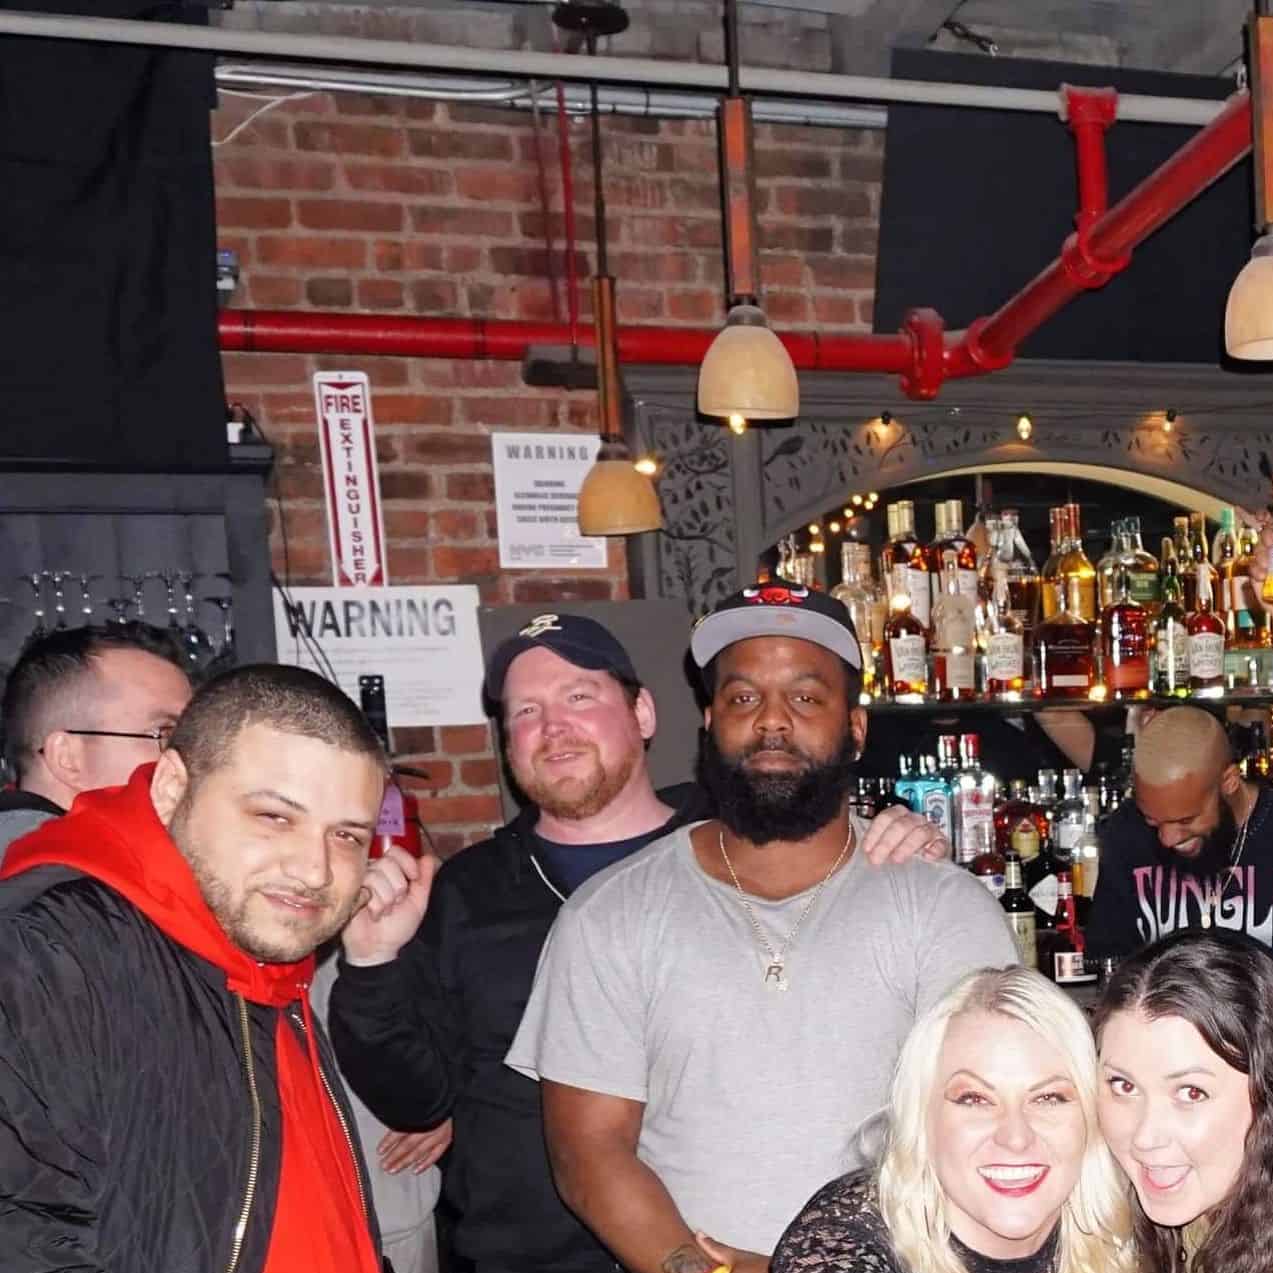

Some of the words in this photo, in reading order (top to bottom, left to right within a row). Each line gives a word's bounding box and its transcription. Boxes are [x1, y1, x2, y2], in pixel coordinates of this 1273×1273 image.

[322, 394, 363, 414] FIRE
[506, 445, 589, 460] WARNING
[338, 418, 367, 585] EXTINGUISHER
[283, 598, 456, 638] WARNING
